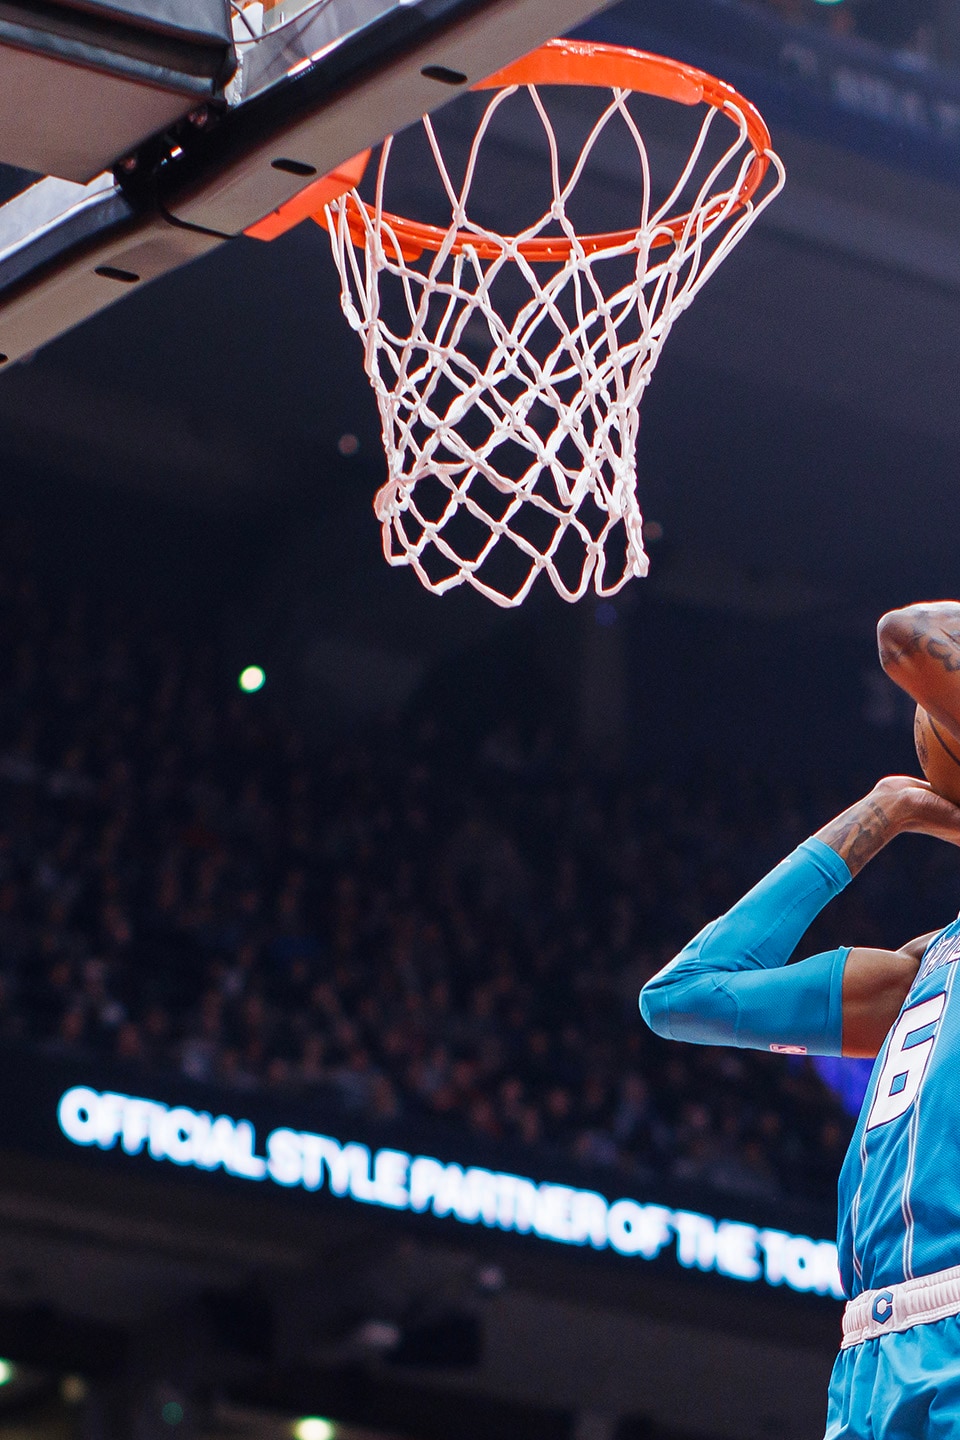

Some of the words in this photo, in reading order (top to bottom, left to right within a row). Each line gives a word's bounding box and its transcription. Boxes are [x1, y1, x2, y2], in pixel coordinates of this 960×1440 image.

[866, 991, 946, 1132] 6
[57, 1085, 267, 1180] OFFICIAL
[267, 1127, 411, 1209] STYLE
[410, 1156, 608, 1250] PARTNER
[607, 1197, 672, 1259] OF
[672, 1208, 762, 1281] THE
[872, 1290, 893, 1325] C
